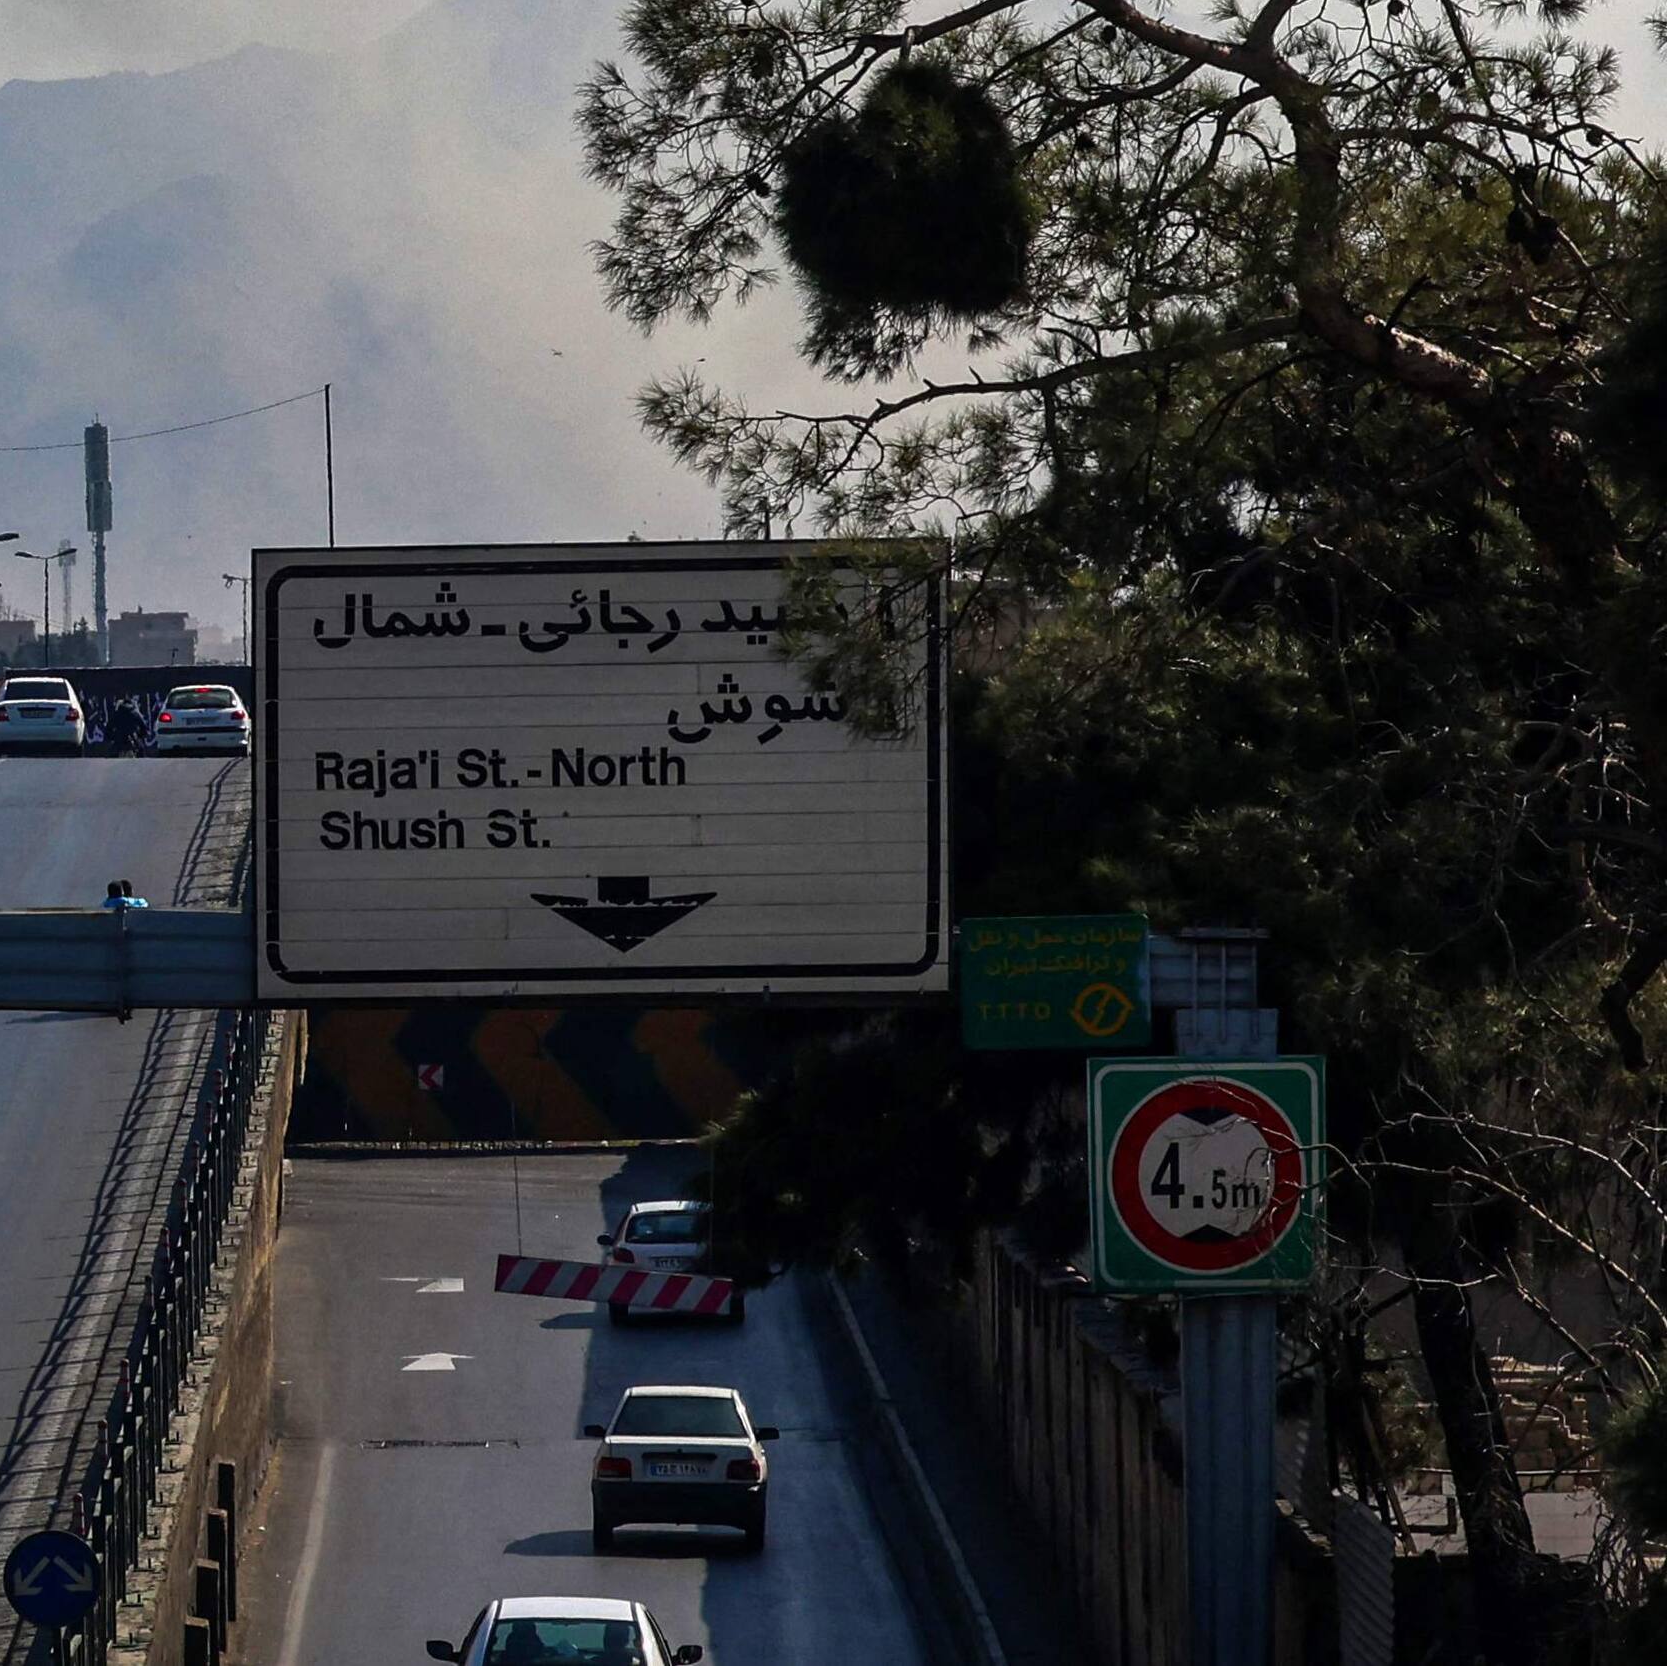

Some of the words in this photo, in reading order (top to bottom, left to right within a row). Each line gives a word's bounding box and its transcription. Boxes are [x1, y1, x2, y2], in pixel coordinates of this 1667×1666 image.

[315, 749, 439, 797] Raja'i
[320, 809, 465, 850] Shush
[486, 809, 551, 849] St.
